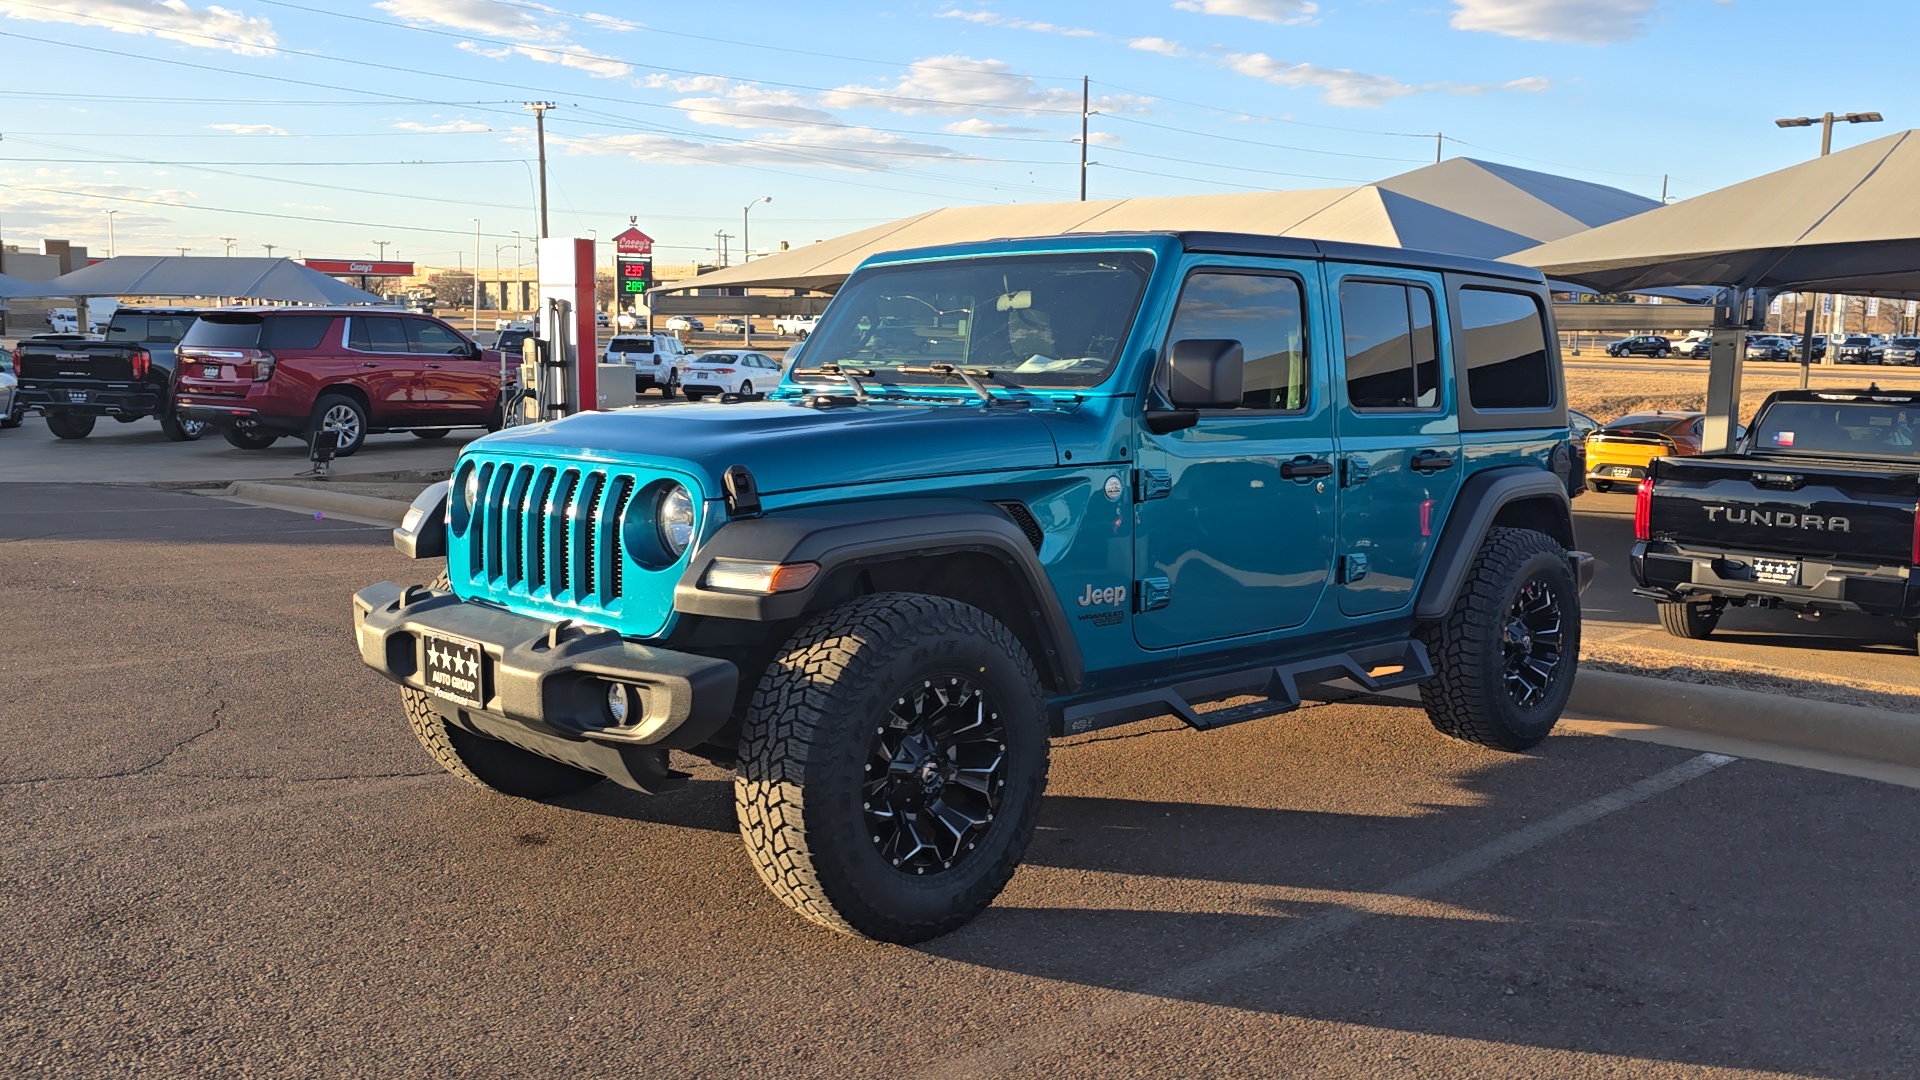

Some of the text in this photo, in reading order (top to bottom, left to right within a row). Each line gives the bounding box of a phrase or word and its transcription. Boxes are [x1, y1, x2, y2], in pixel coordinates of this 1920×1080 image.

[619, 237, 650, 251] Casey's
[350, 262, 372, 273] Casey's
[1702, 505, 1850, 532] TUNDRA
[1078, 584, 1126, 606] Jeep
[1078, 610, 1124, 620] WRANGLER
[432, 671, 475, 693] AUTO GROUP
